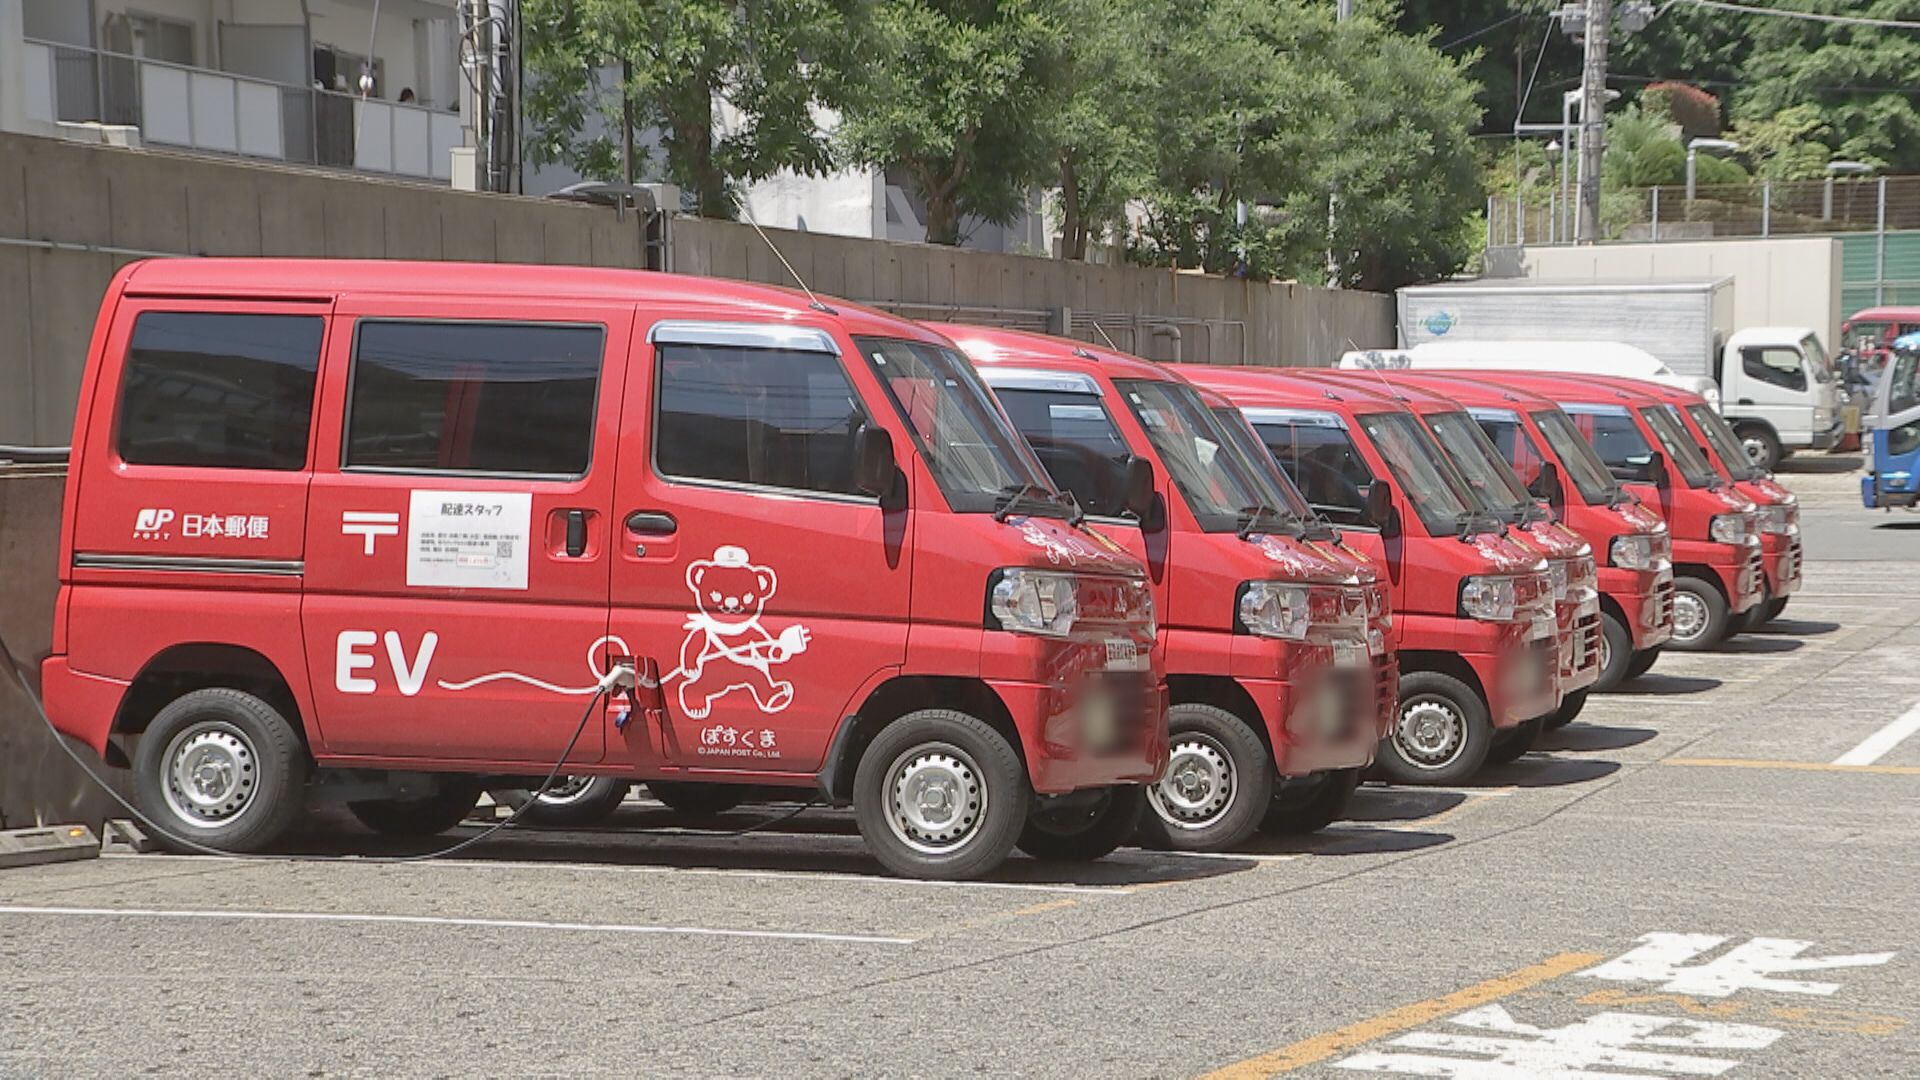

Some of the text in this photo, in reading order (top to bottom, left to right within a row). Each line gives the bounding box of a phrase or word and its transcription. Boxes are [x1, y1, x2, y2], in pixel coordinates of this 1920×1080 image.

[135, 508, 175, 531] JP
[440, 502, 503, 516] 配達スタッフ
[132, 532, 171, 541] POST
[182, 513, 269, 539] 日本郵便
[335, 630, 439, 697] EV
[700, 724, 776, 749] ぽすくま
[706, 747, 730, 756] JAPAN
[731, 748, 751, 757] POST
